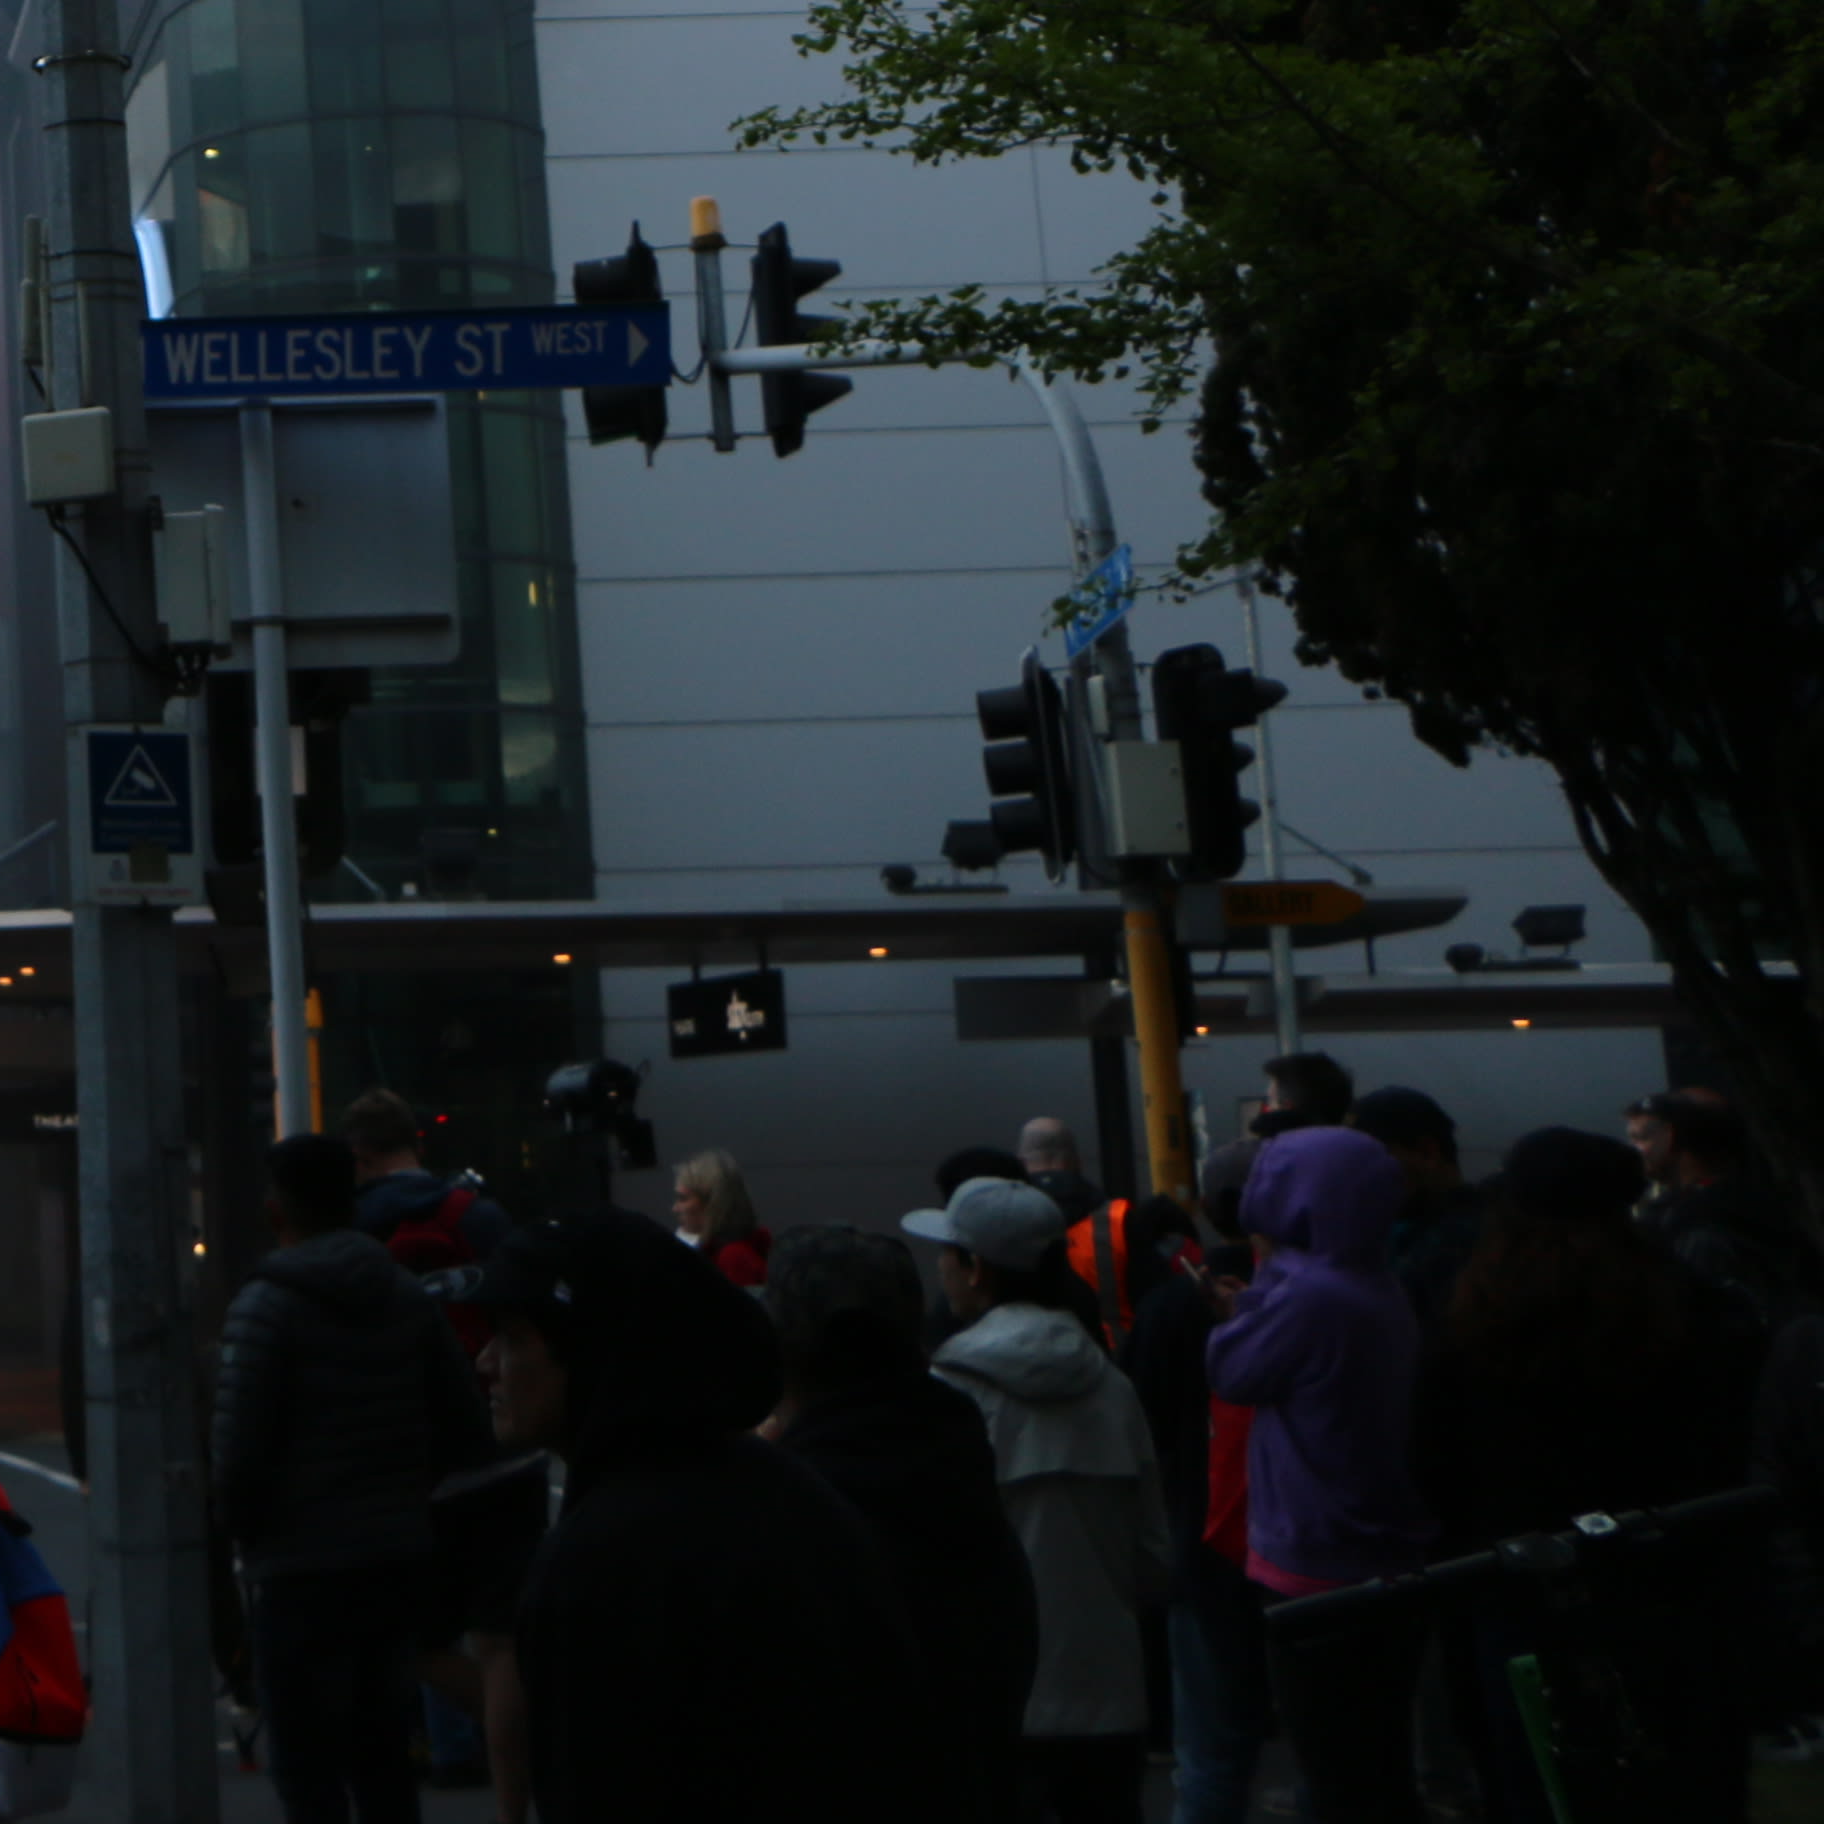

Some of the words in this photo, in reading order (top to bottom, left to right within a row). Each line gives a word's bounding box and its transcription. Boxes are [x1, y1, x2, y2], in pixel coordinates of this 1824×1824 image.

[162, 324, 433, 385] WELLESLEY
[453, 321, 513, 378] ST
[529, 319, 609, 357] WEST
[1229, 889, 1317, 917] GALLERY
[32, 1112, 80, 1129] THEA
